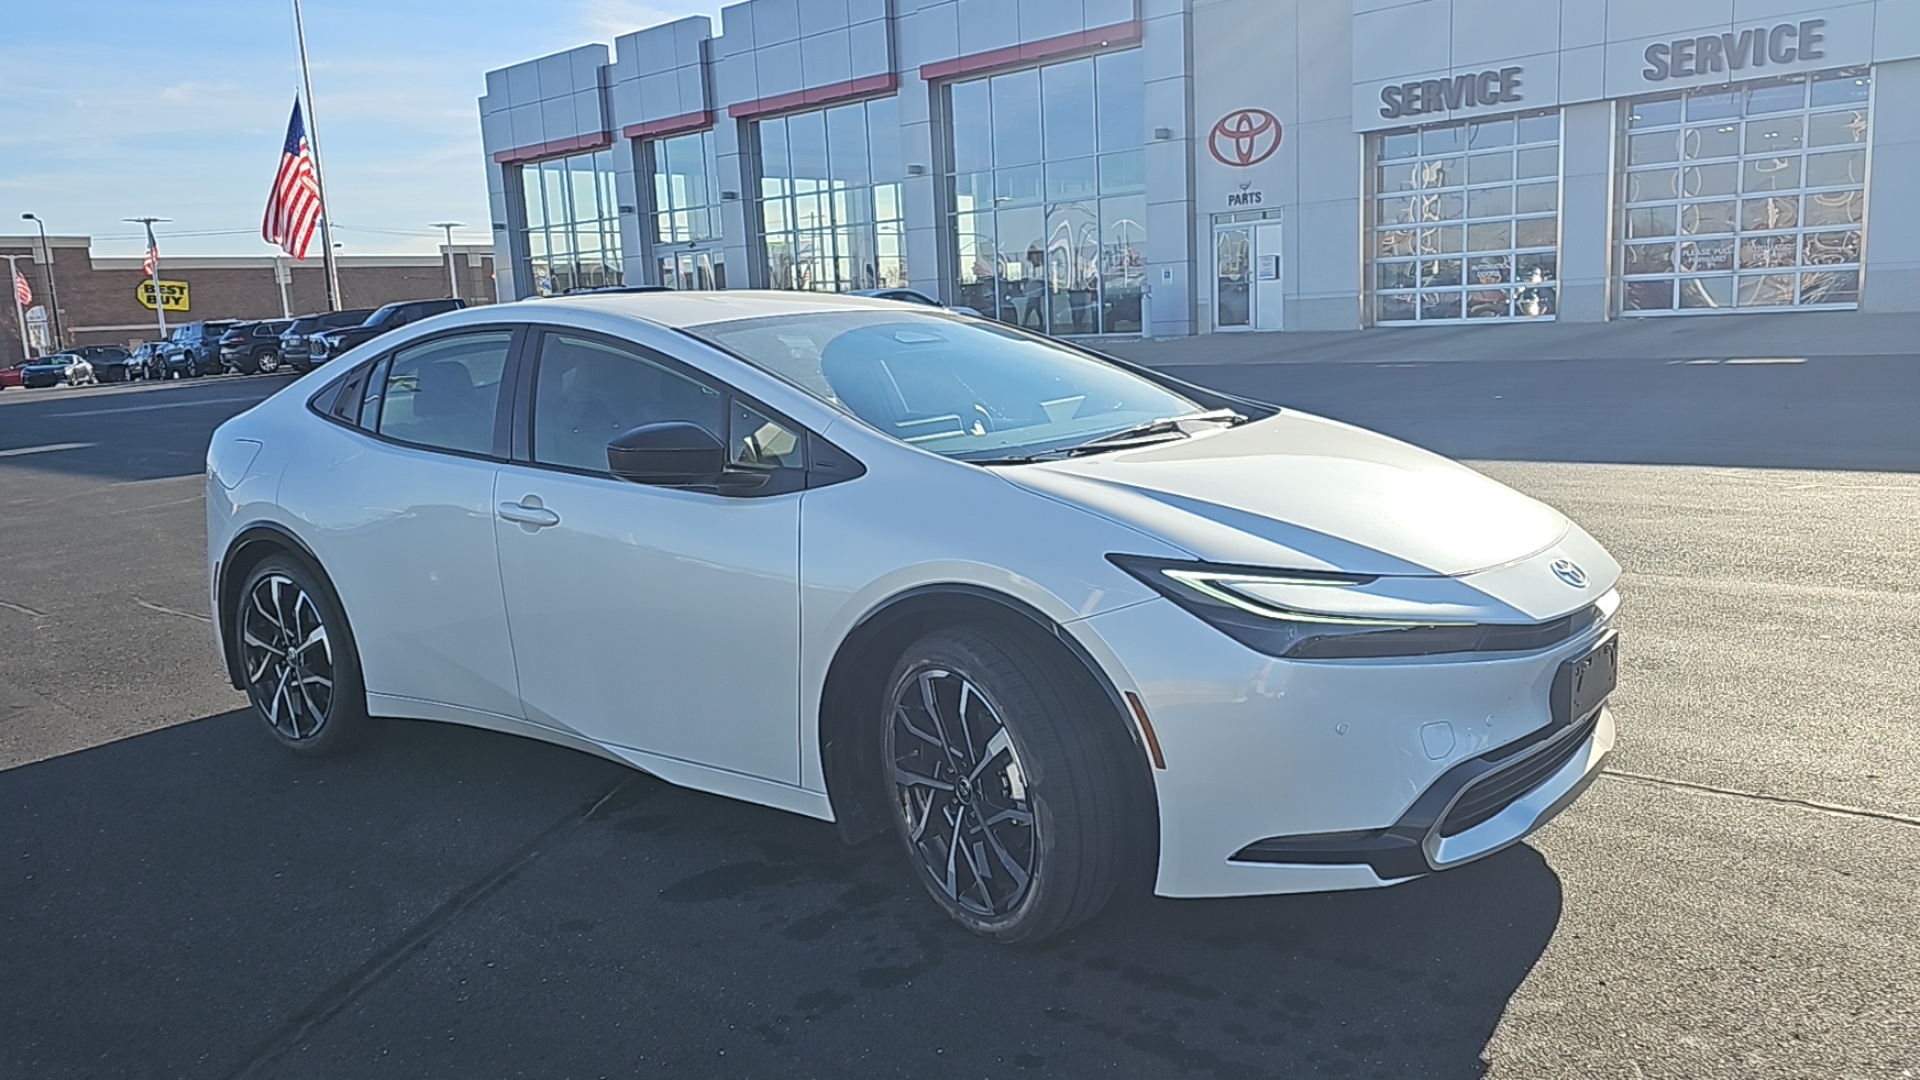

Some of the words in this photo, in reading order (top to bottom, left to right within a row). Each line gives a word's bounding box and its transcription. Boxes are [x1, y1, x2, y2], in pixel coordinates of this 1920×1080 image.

[1643, 19, 1826, 81] SERVICE
[1379, 67, 1523, 119] SERVICE
[1228, 191, 1262, 206] PARTS
[144, 284, 186, 295] BEST
[146, 295, 184, 305] BUY
